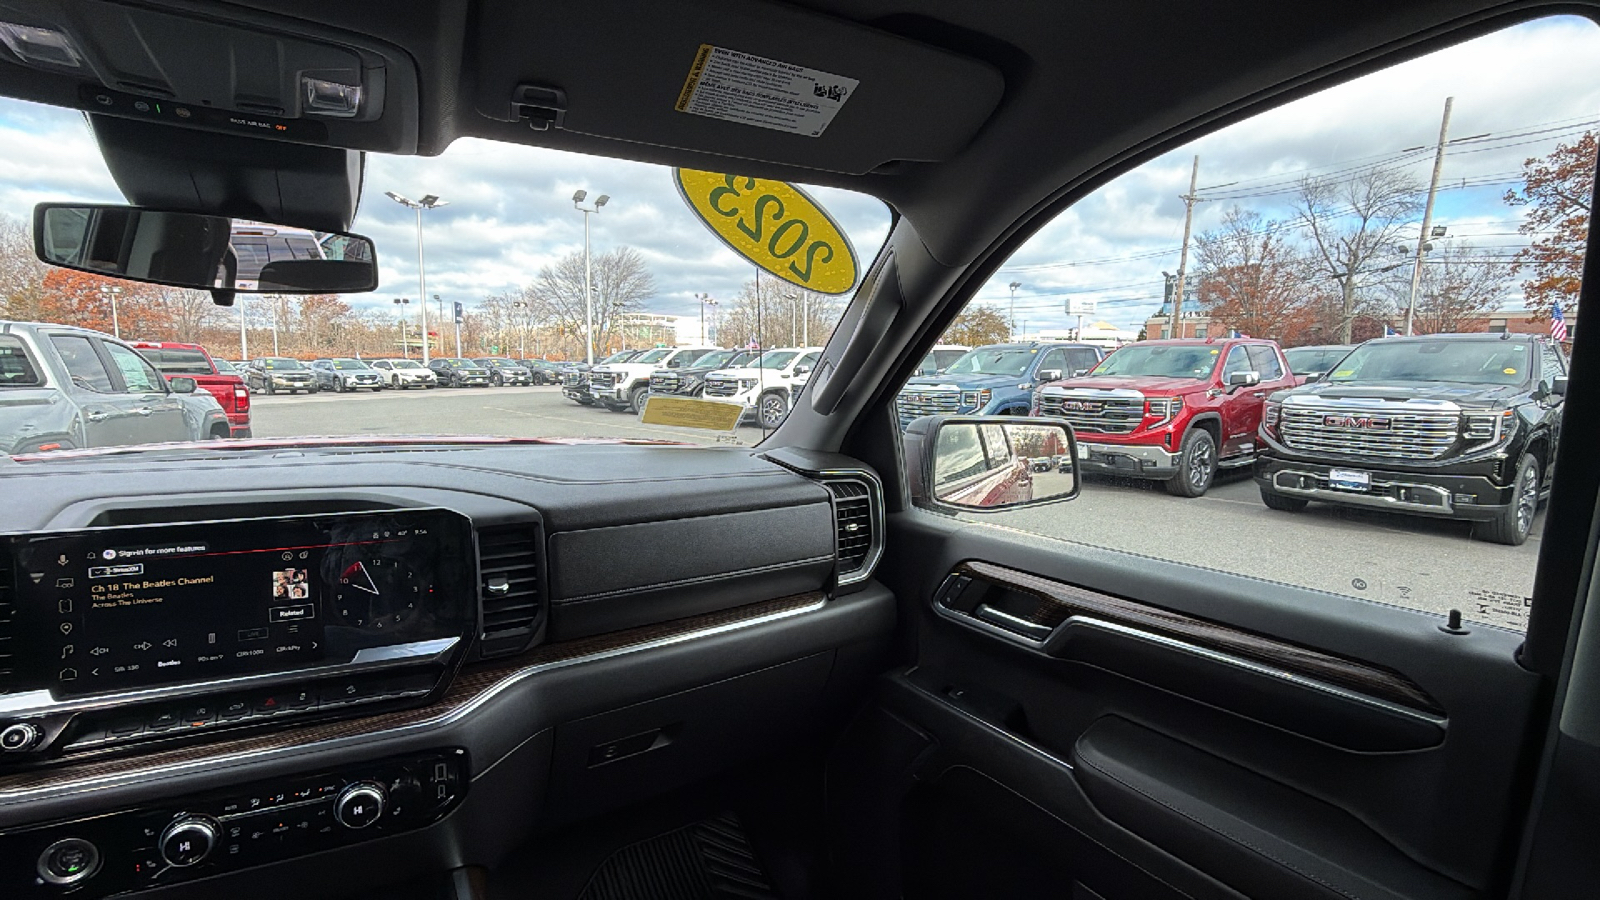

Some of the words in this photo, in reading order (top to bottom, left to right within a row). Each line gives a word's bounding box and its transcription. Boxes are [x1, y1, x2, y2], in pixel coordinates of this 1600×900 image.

[1063, 401, 1102, 411] GMC
[1325, 416, 1389, 429] GMC
[177, 545, 206, 553] features
[91, 585, 105, 593] Ch
[107, 583, 119, 592] 18
[123, 582, 140, 590] The
[142, 580, 176, 589] Beatles
[178, 575, 214, 586] Channel
[107, 592, 134, 600] Beatles
[91, 601, 117, 609] Across
[279, 608, 304, 618] Related
[353, 805, 363, 815] HI
[179, 841, 190, 852] HI
